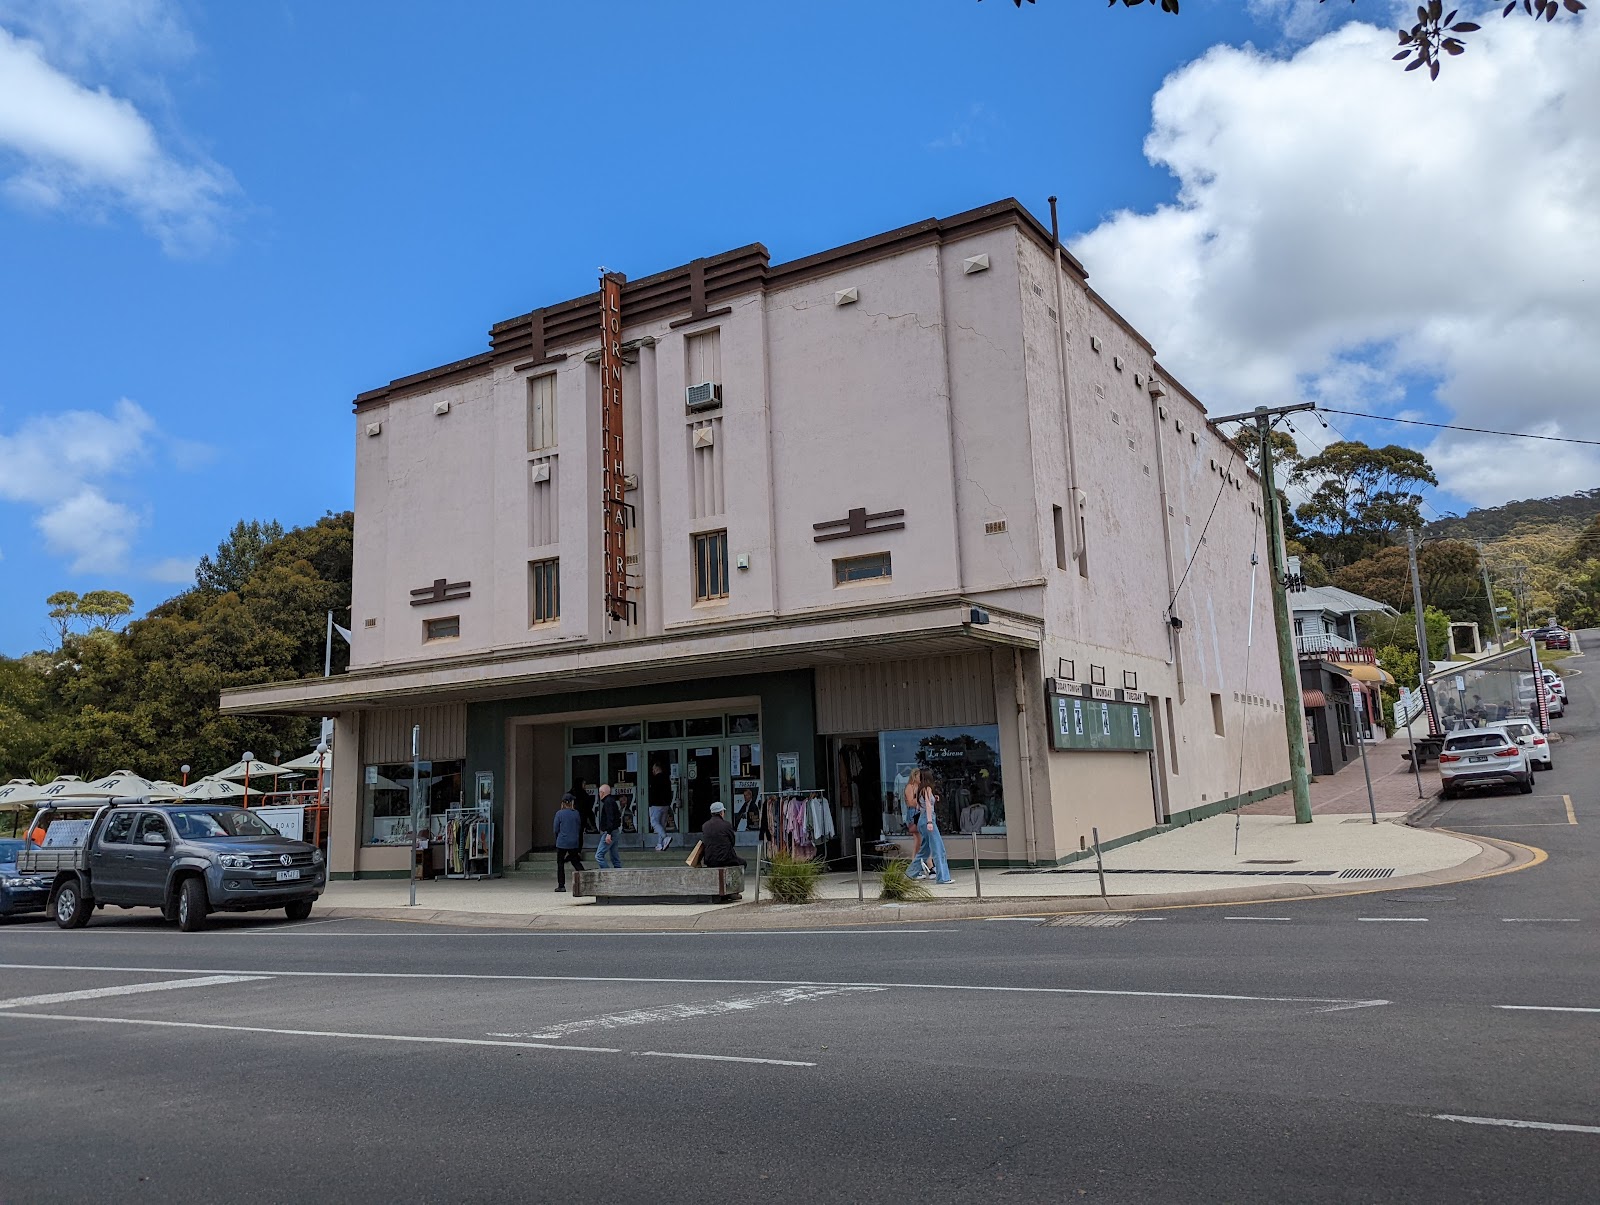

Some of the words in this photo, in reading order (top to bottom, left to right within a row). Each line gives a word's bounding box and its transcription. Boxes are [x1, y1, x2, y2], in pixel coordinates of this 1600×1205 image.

[610, 293, 620, 405] LORNE
[613, 434, 625, 599] THEATRE
[1095, 687, 1112, 699] MONDAY
[1126, 691, 1142, 702] TUESDAY
[927, 747, 938, 757] La
[253, 763, 267, 772] JR
[41, 784, 66, 794] JR
[95, 779, 121, 789] JR
[218, 783, 234, 793] JR
